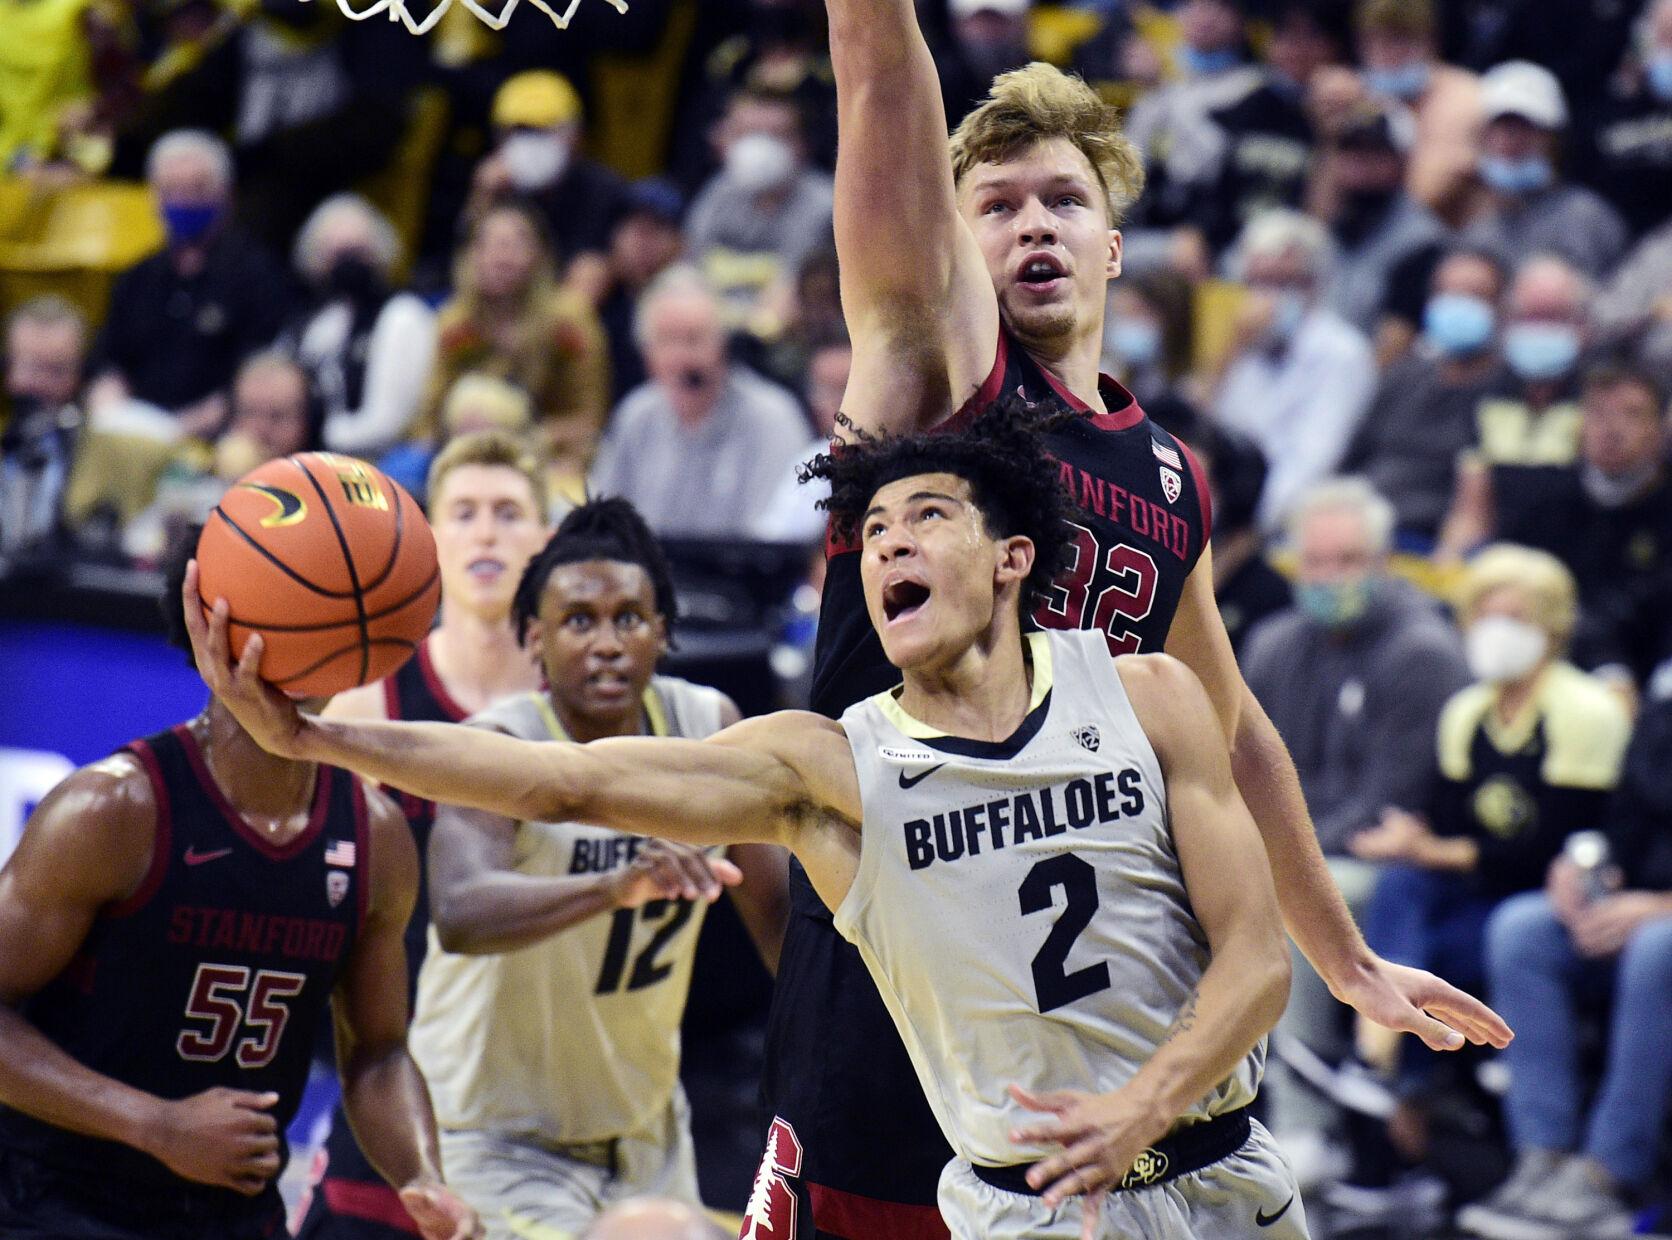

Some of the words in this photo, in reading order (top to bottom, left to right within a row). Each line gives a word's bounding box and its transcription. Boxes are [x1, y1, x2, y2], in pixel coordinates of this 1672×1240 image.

[1044, 451, 1190, 561] ANFORD
[1031, 519, 1159, 655] 32
[904, 768, 1145, 871] BUFFALOES
[168, 906, 347, 962] STANFORD
[595, 896, 694, 995] 12
[1018, 852, 1112, 1014] 2
[177, 962, 307, 1069] 55
